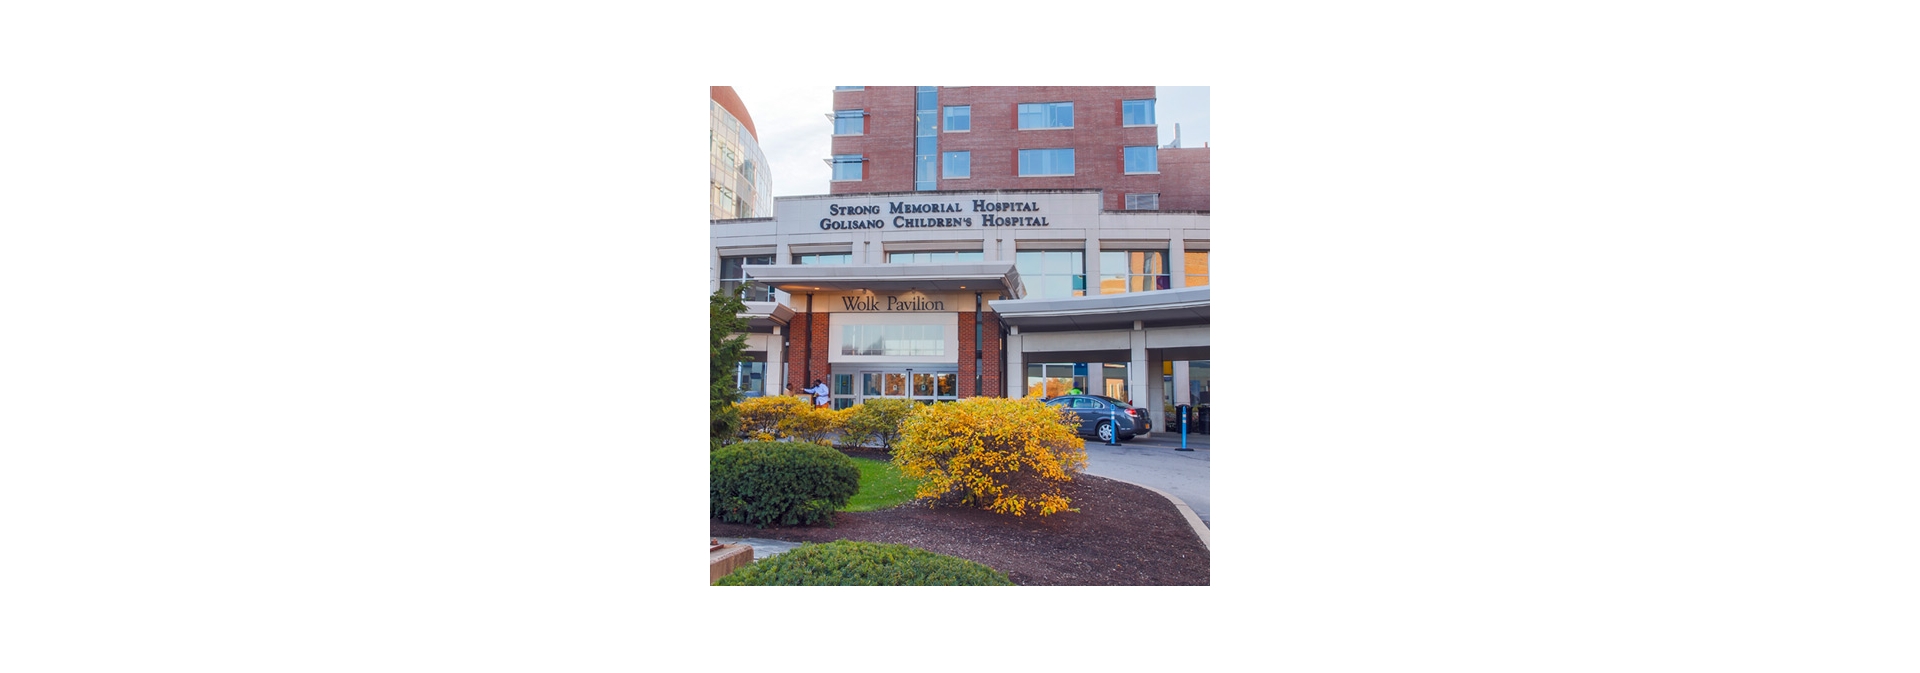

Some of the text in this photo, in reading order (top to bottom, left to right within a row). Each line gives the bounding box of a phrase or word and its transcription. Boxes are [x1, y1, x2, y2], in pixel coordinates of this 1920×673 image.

[830, 199, 1040, 216] STRONG MEMORIAL HOSPITAL
[820, 218, 884, 230] GOLISANO
[982, 214, 1050, 227] HOSPITAL
[842, 296, 945, 311] Wolk Pavilion
